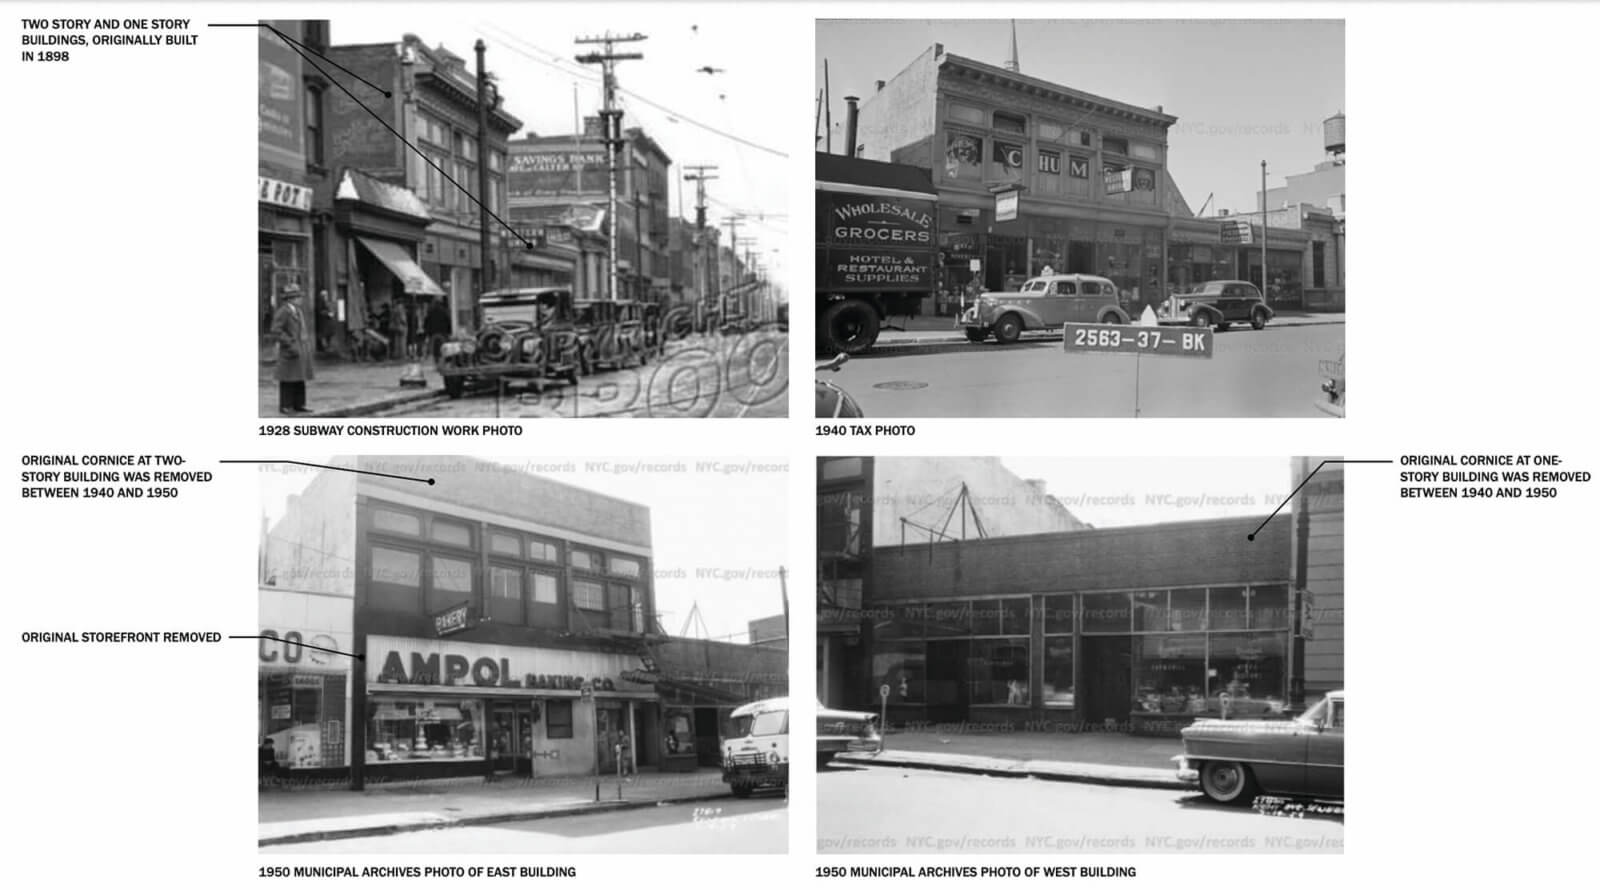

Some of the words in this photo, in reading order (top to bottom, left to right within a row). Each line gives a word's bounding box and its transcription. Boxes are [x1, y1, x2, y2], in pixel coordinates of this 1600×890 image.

[513, 154, 564, 164] SAVINGS
[570, 154, 605, 164] BANK
[834, 203, 933, 229] WHOLESALE
[834, 226, 930, 242] GROCERS
[849, 255, 901, 265] HOTEL
[903, 256, 915, 265] &
[836, 264, 928, 273] RESTAURANT
[845, 274, 920, 283] SUPPLIES
[379, 650, 521, 688] AMPOL
